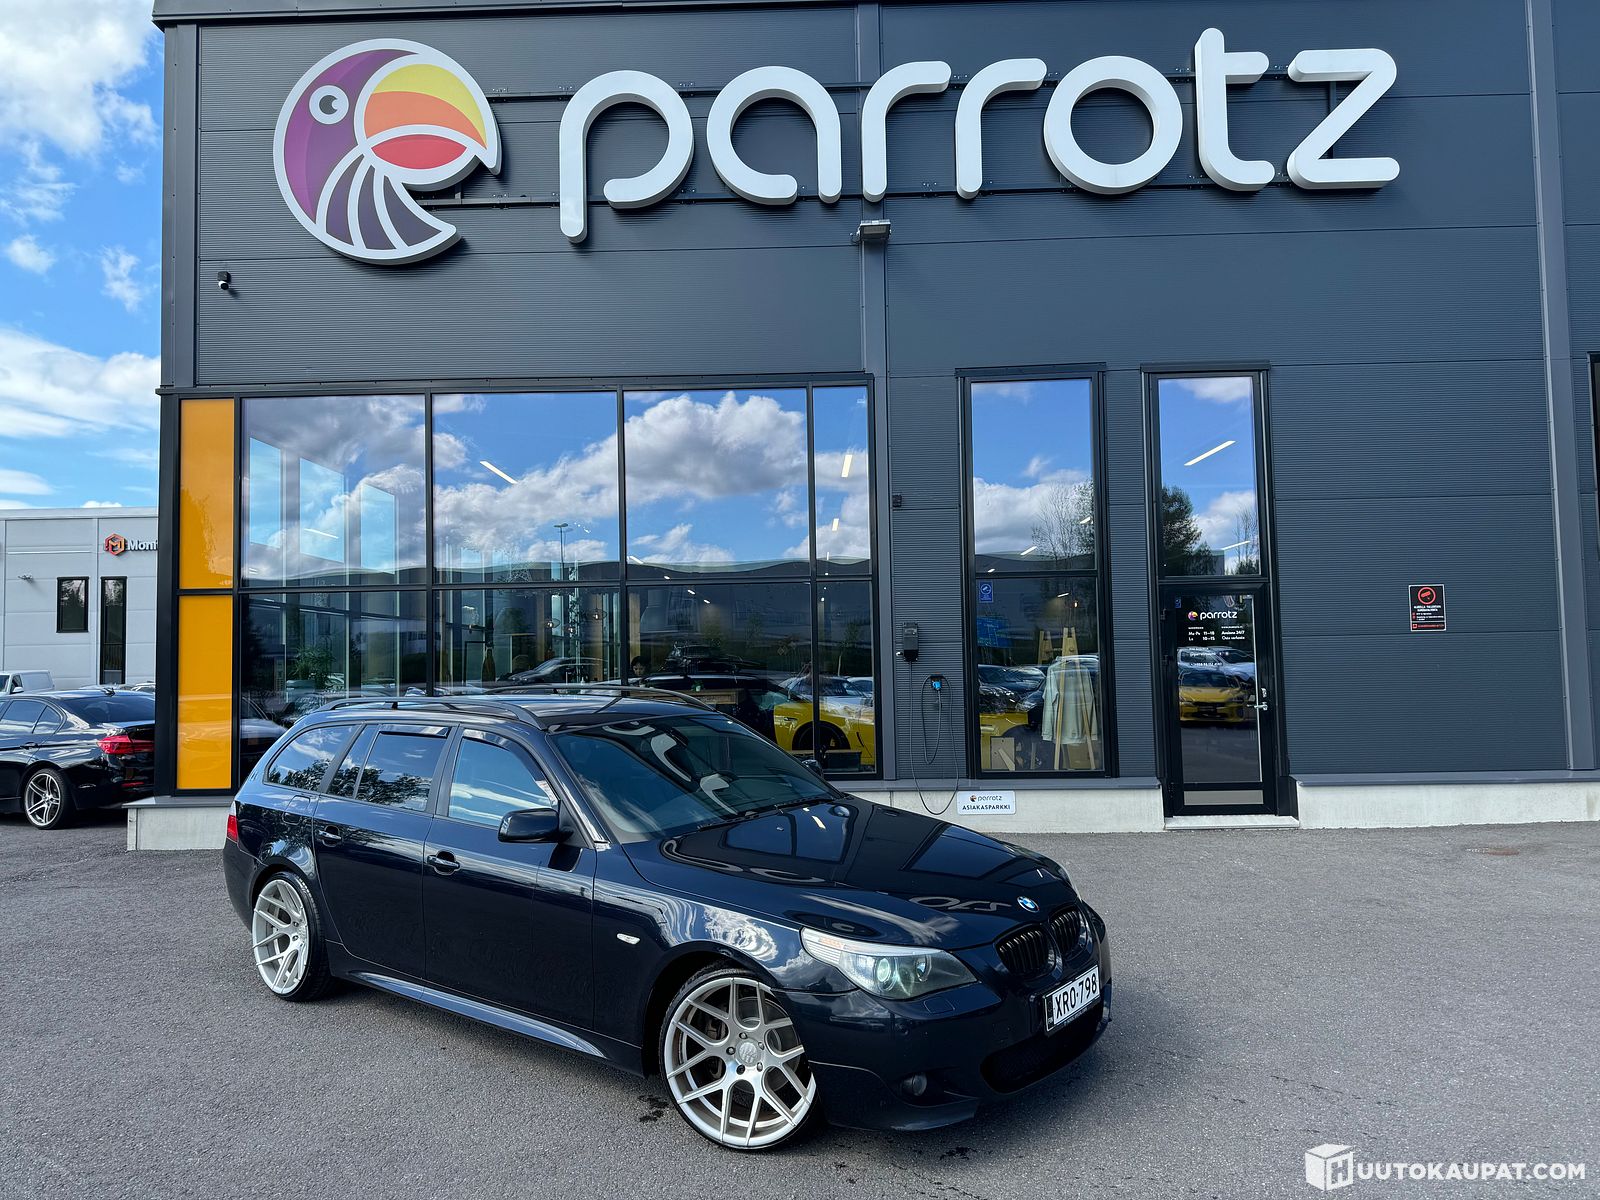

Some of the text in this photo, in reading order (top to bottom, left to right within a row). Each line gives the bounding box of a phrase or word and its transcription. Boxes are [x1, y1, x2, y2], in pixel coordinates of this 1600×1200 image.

[559, 27, 1400, 243] parrotz
[1200, 610, 1238, 621] parrotz
[1055, 973, 1097, 1019] XRO-798
